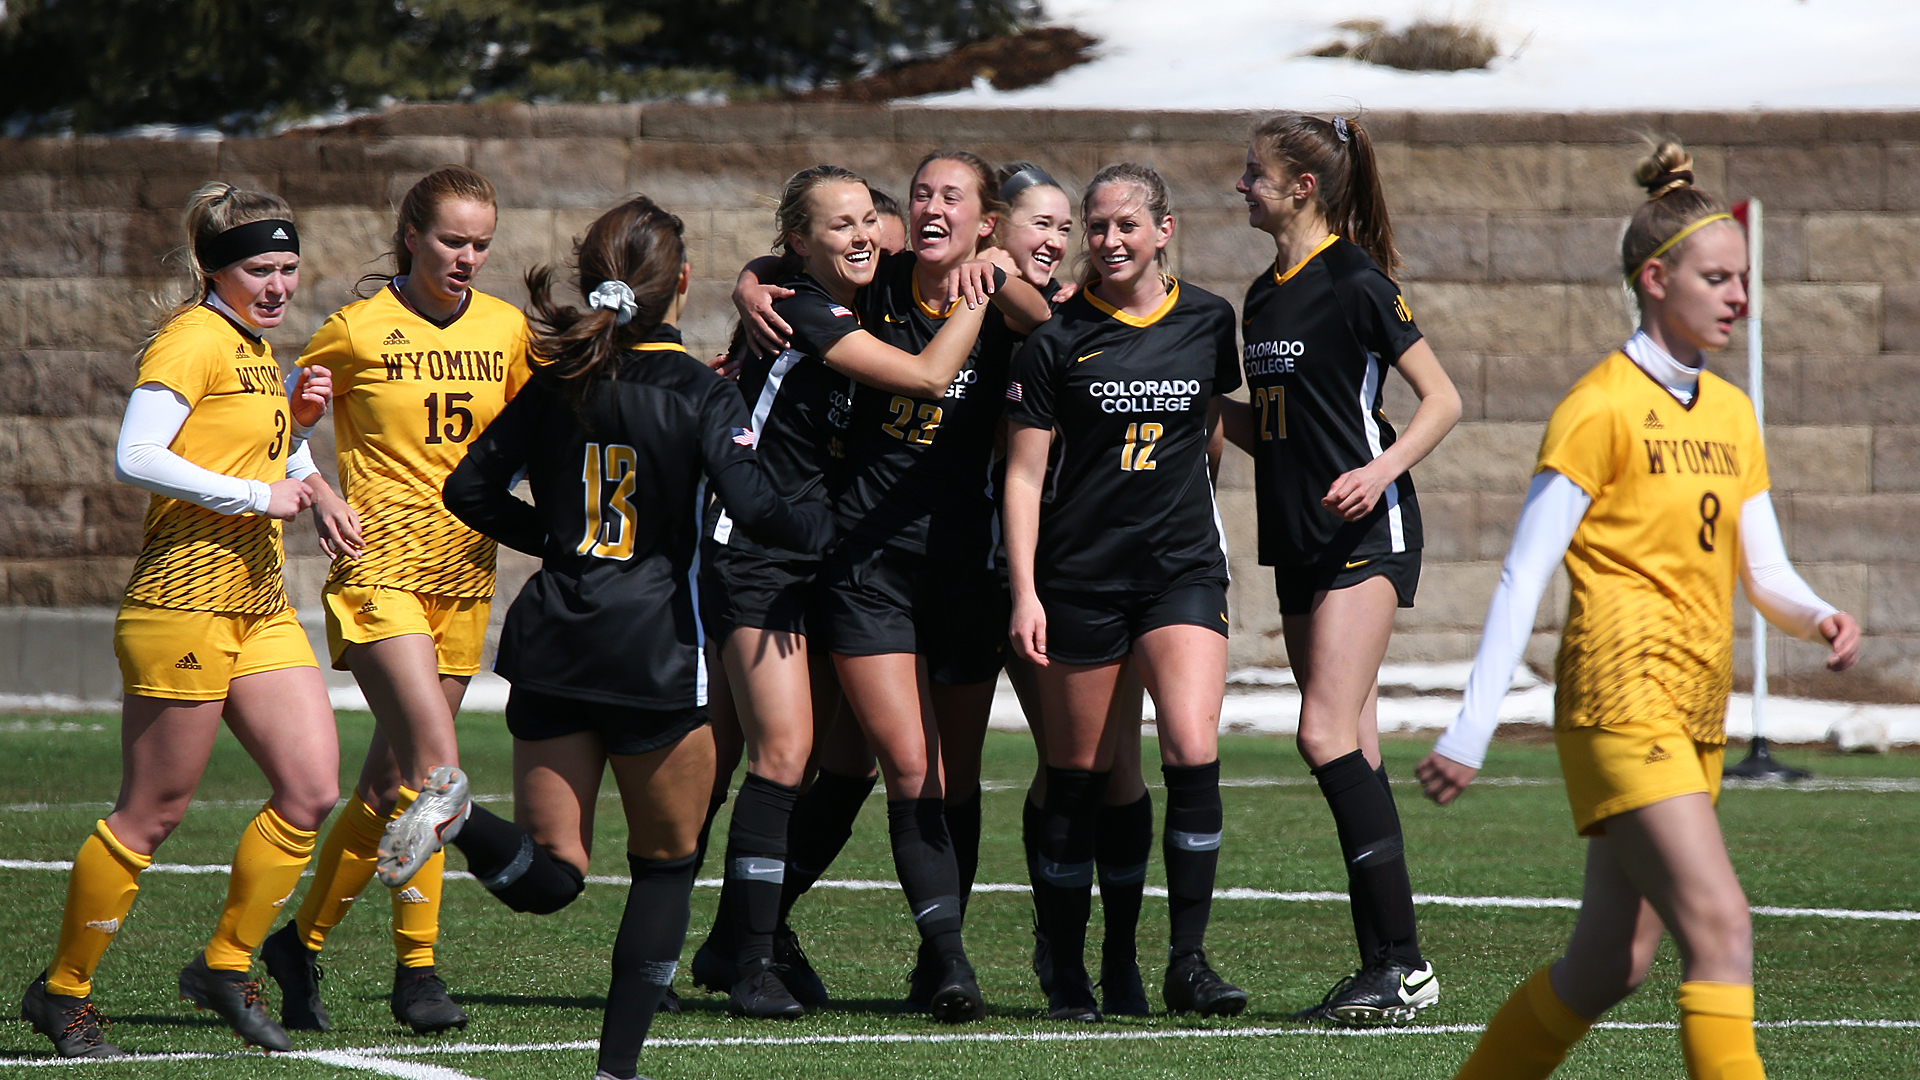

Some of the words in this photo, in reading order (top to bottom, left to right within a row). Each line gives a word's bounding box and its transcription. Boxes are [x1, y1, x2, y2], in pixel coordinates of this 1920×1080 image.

[380, 350, 504, 382] WYOMING
[1089, 379, 1201, 397] COLORADO
[1245, 357, 1295, 377] COLLEGE
[424, 391, 474, 444] 15
[881, 395, 943, 445] 23
[1101, 397, 1192, 414] COLLEGE
[1255, 385, 1287, 440] 27
[268, 409, 286, 461] 3
[1121, 422, 1164, 472] 12
[1643, 439, 1741, 477] WYOMIN
[576, 442, 638, 561] 13
[1698, 492, 1720, 552] 8
[175, 662, 202, 670] adidas
